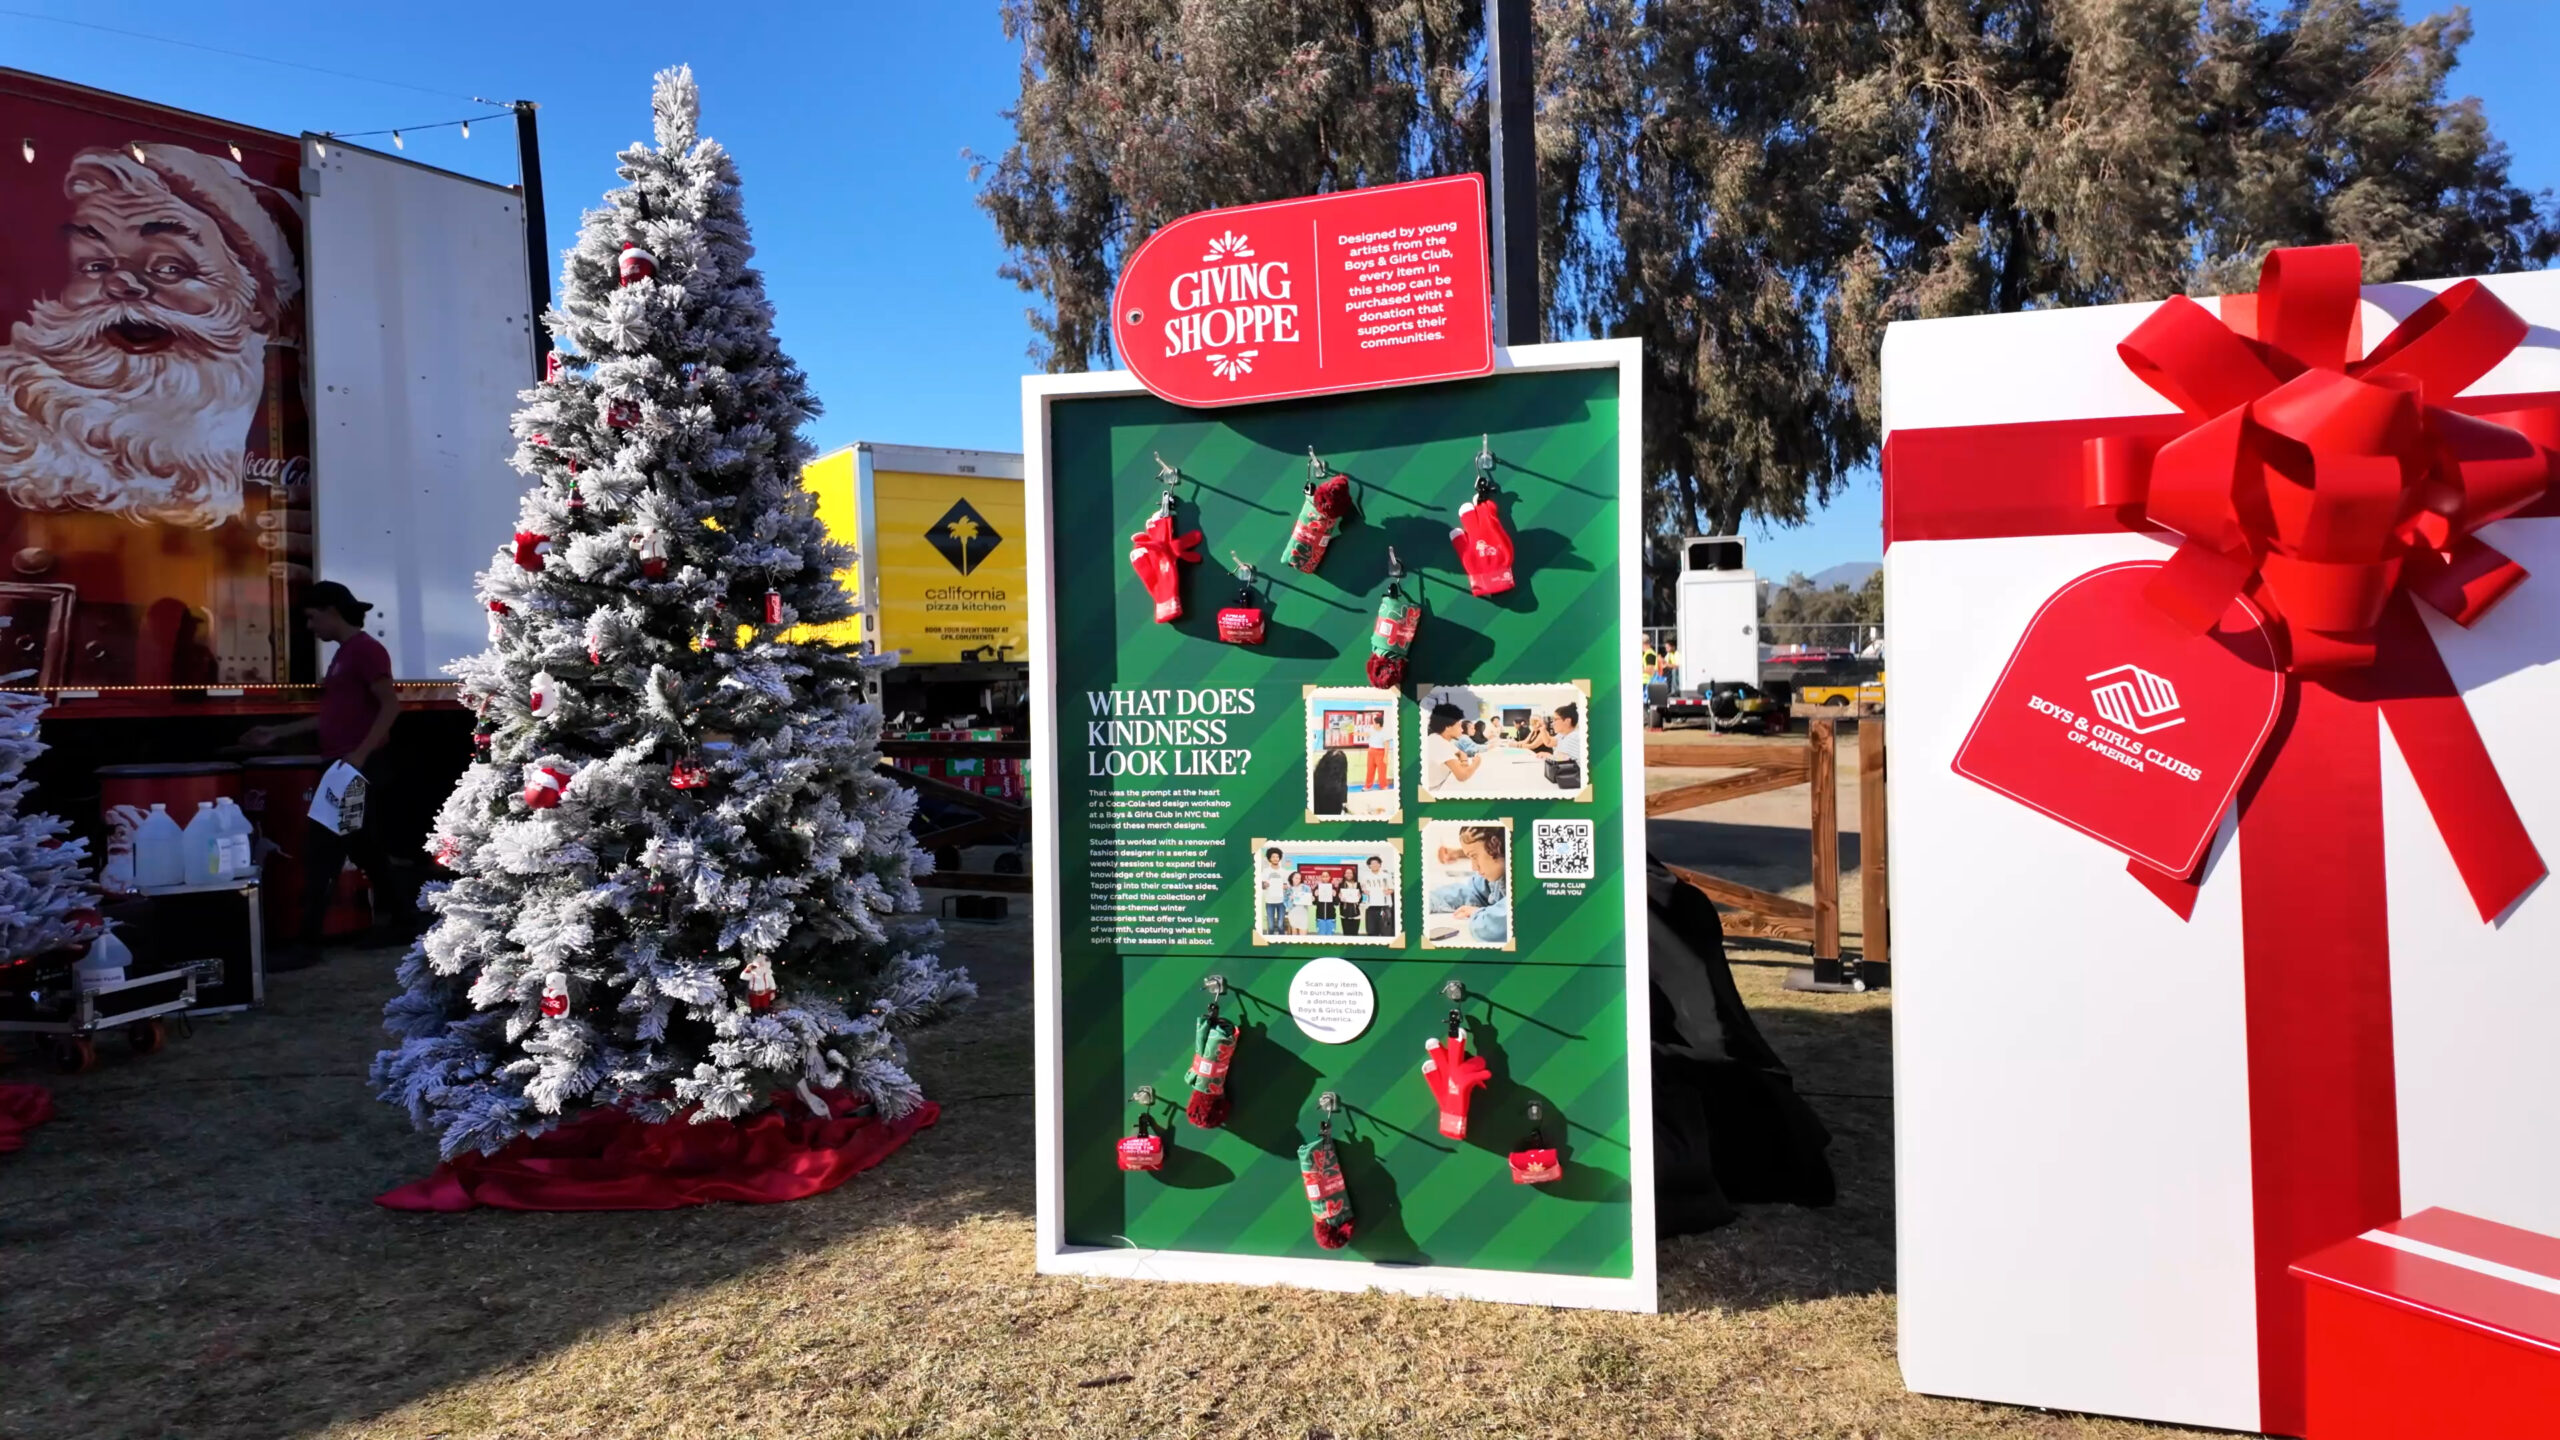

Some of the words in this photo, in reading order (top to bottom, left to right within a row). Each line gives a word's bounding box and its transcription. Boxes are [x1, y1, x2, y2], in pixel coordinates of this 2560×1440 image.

[1339, 229, 1396, 244] Designed
[1399, 227, 1415, 237] by
[1418, 222, 1457, 236] young
[1349, 241, 1390, 256] artists
[1392, 240, 1423, 250] from
[1425, 236, 1447, 246] the
[1344, 259, 1375, 270] Boys
[1377, 256, 1387, 266] &
[1389, 252, 1419, 264] Girls
[1421, 248, 1453, 260] Club,
[1358, 270, 1394, 282] every
[1396, 266, 1425, 277] item
[1428, 263, 1439, 273] in
[1170, 262, 1291, 311] GIVING
[1348, 285, 1373, 296] this
[1375, 282, 1406, 293] shop
[1409, 278, 1432, 289] can
[1435, 275, 1451, 285] be
[1345, 293, 1411, 312] purchased
[1413, 289, 1442, 301] with
[1444, 289, 1453, 298] a
[1358, 308, 1415, 322] donation
[1417, 303, 1444, 314] that
[1165, 304, 1299, 357] SHOPPE
[1357, 321, 1414, 336] supports
[1416, 316, 1447, 328] their
[1360, 331, 1445, 348] communities.
[244, 451, 310, 487] Coca-Co
[925, 585, 1006, 600] california
[926, 601, 959, 611] pizza
[962, 602, 1006, 611] kitchen
[1087, 690, 1171, 716] WHAT
[1177, 688, 1255, 715] DOES
[1088, 719, 1227, 746] KINDNESS
[2027, 695, 2074, 724] BOYS
[2075, 716, 2089, 732] &
[2092, 724, 2143, 755] GIRLS
[2145, 749, 2202, 781] CLUBS
[2068, 730, 2087, 746] OF
[2087, 738, 2144, 772] AMERICA
[1088, 750, 1169, 776] LOOK
[1174, 749, 1252, 776] LIKE?
[1141, 789, 1171, 797] prompt
[1183, 788, 1197, 796] the
[1162, 800, 1189, 808] design
[1190, 800, 1231, 808] workshop
[1106, 811, 1125, 819] Boys
[1134, 810, 1153, 818] Girls
[1154, 810, 1174, 818] Club
[1184, 810, 1201, 818] NYC
[1089, 821, 1121, 830] inspired
[1123, 821, 1145, 829] these
[1173, 822, 1207, 830] designs.
[1089, 838, 1125, 846] Students
[1185, 838, 1226, 846] renowned
[1120, 849, 1155, 857] designer
[1090, 860, 1118, 868] weekly
[1166, 860, 1195, 868] expand
[1197, 860, 1216, 868] their
[1090, 871, 1134, 879] knowledge
[1160, 871, 1187, 880] design
[1090, 882, 1121, 890] Tapping
[1123, 881, 1139, 889] into
[1195, 882, 1218, 890] sides,
[1109, 892, 1139, 900] crafted
[1157, 893, 1195, 901] collection
[1156, 914, 1176, 922] offer
[1194, 916, 1219, 924] layers
[1100, 925, 1133, 933] warmth,
[1135, 926, 1173, 934] capturing
[1175, 926, 1195, 934] what
[1090, 936, 1111, 944] spirit
[1123, 936, 1137, 944] the
[1189, 937, 1214, 945] about.
